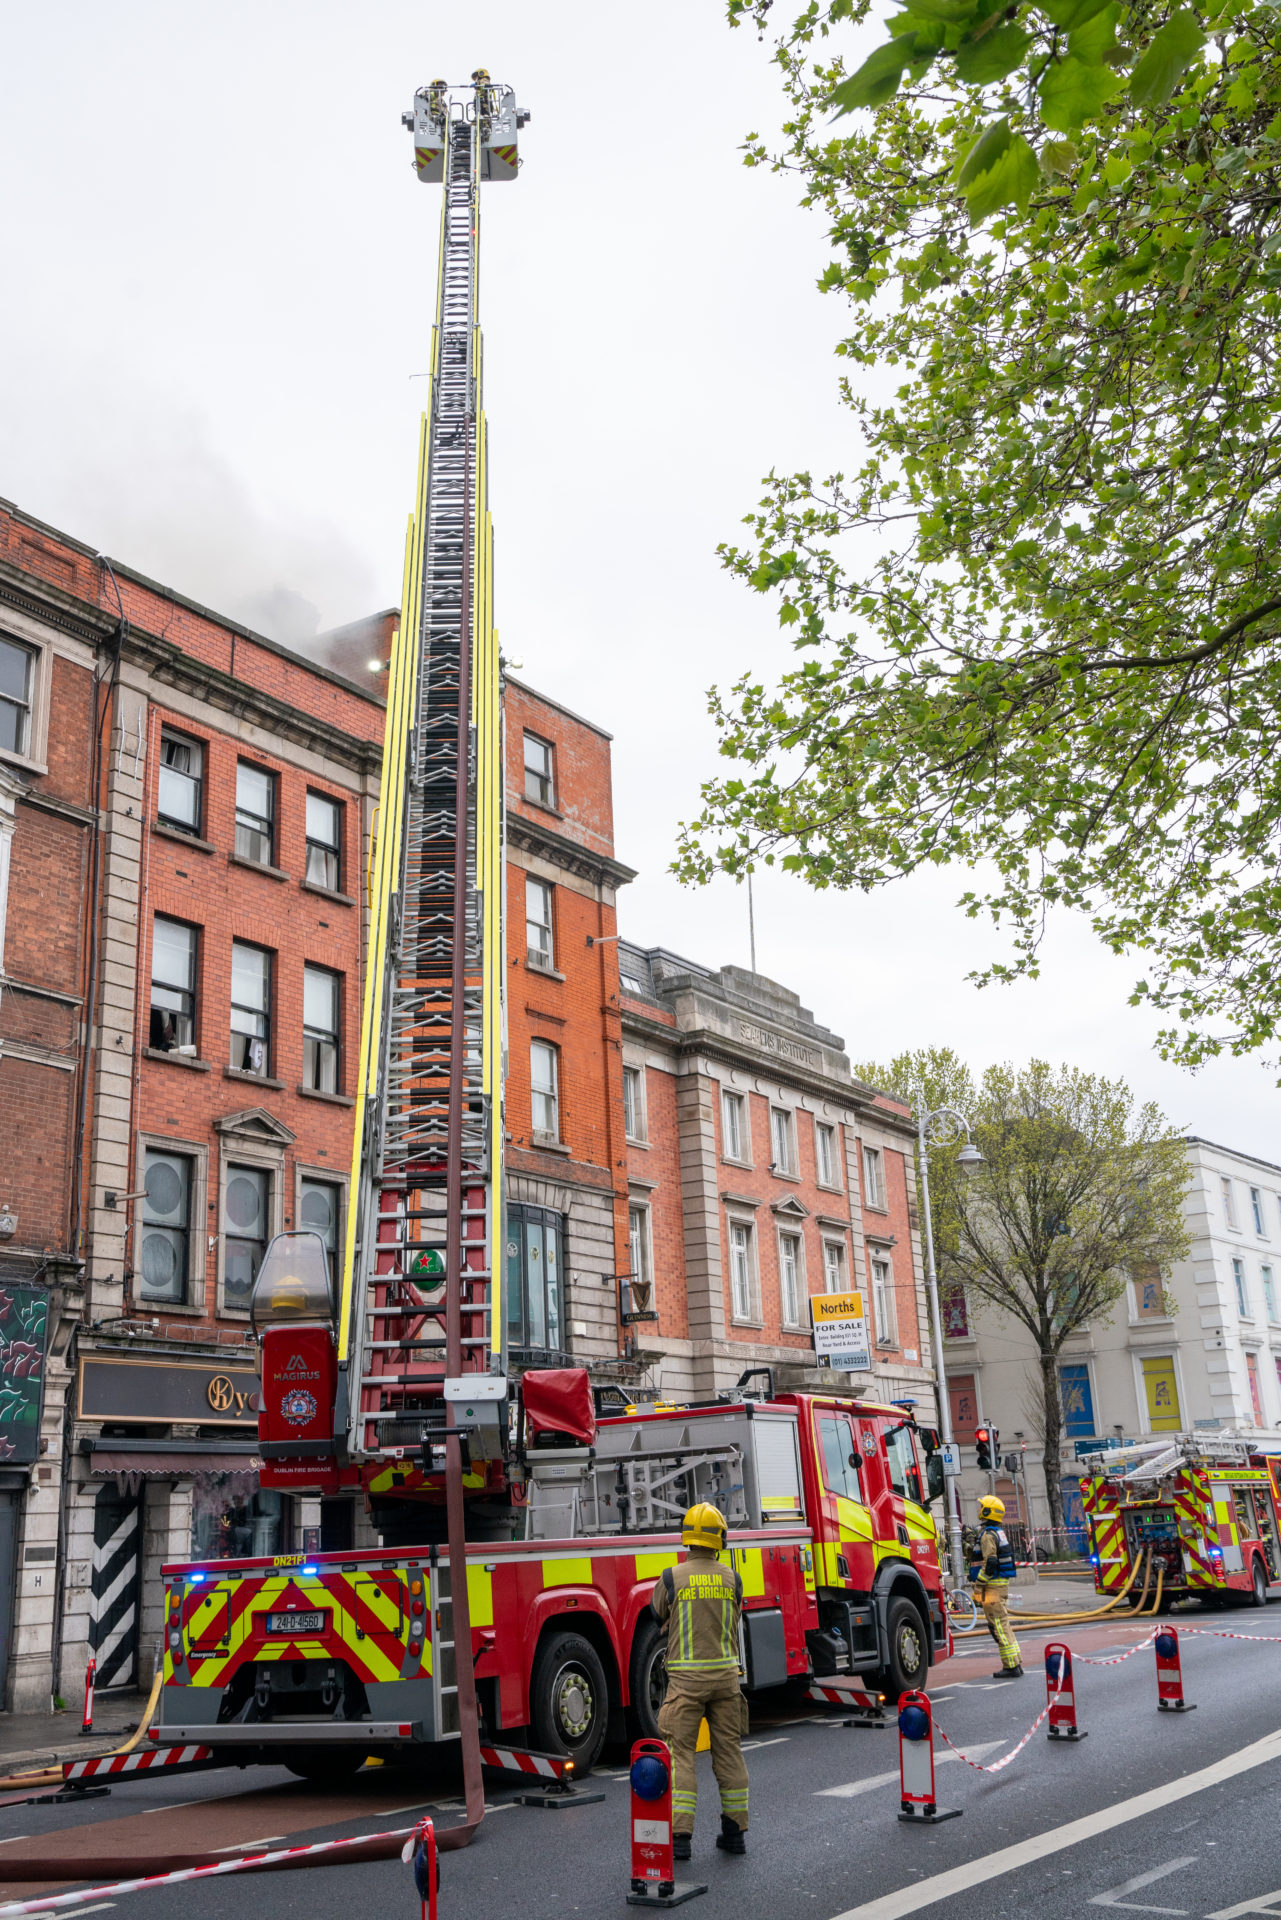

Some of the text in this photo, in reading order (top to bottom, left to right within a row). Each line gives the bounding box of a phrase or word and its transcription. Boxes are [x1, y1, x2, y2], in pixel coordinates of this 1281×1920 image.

[777, 1037, 814, 1065] INSTITUTE
[820, 1300, 854, 1315] Norths
[626, 1313, 653, 1321] GUINNESS
[816, 1322, 862, 1332] FOR SALE
[832, 1357, 843, 1366] (01)
[273, 1371, 320, 1381] MAGIRUS
[273, 1555, 307, 1567] DN21F1
[689, 1574, 722, 1586] DUBLIN
[678, 1587, 733, 1600] FIRE BRIGADE
[276, 1615, 319, 1628] 241-D-41560
